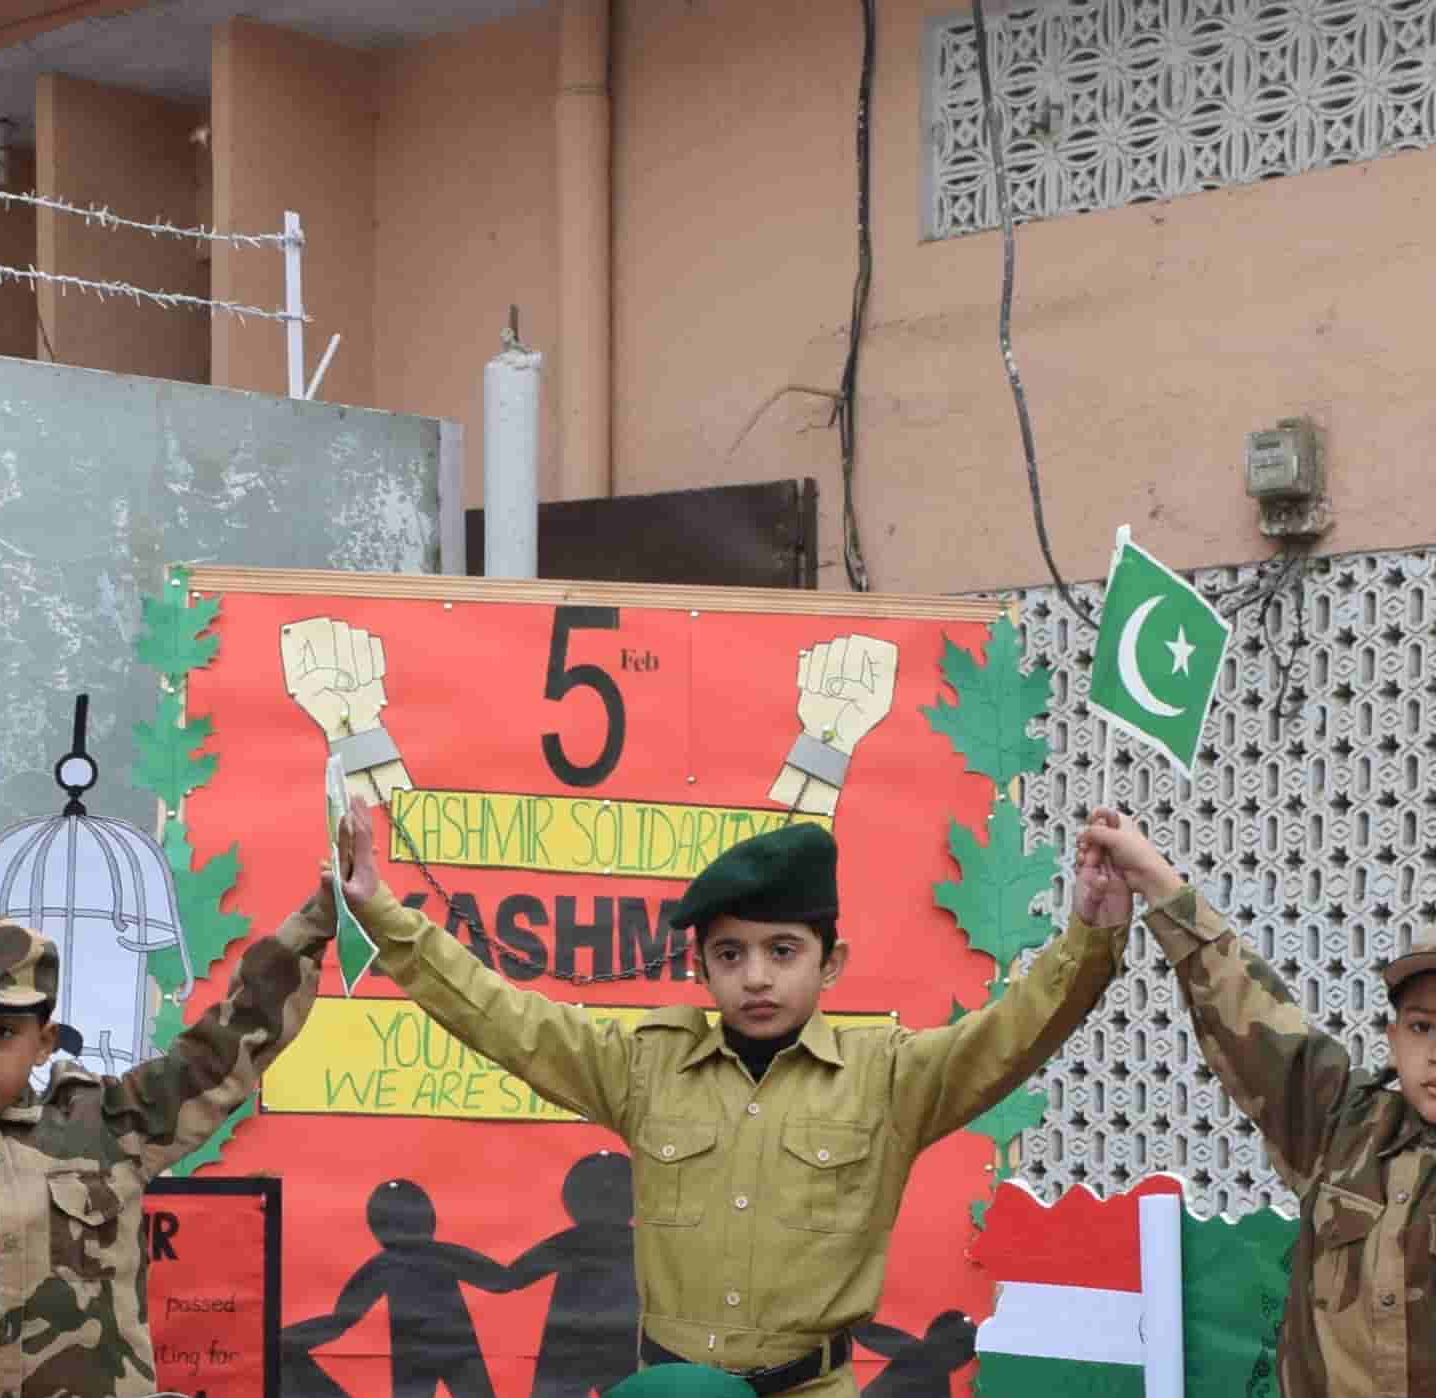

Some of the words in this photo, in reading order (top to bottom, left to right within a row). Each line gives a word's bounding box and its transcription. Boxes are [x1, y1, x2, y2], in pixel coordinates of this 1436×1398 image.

[541, 605, 627, 788] 5
[620, 648, 660, 672] Feb
[396, 792, 552, 866] KASHMIR
[369, 892, 702, 983] ASHM
[325, 1068, 397, 1108] WE
[411, 1071, 485, 1111] ARE
[165, 1294, 235, 1321] passed
[208, 1337, 239, 1365] for
